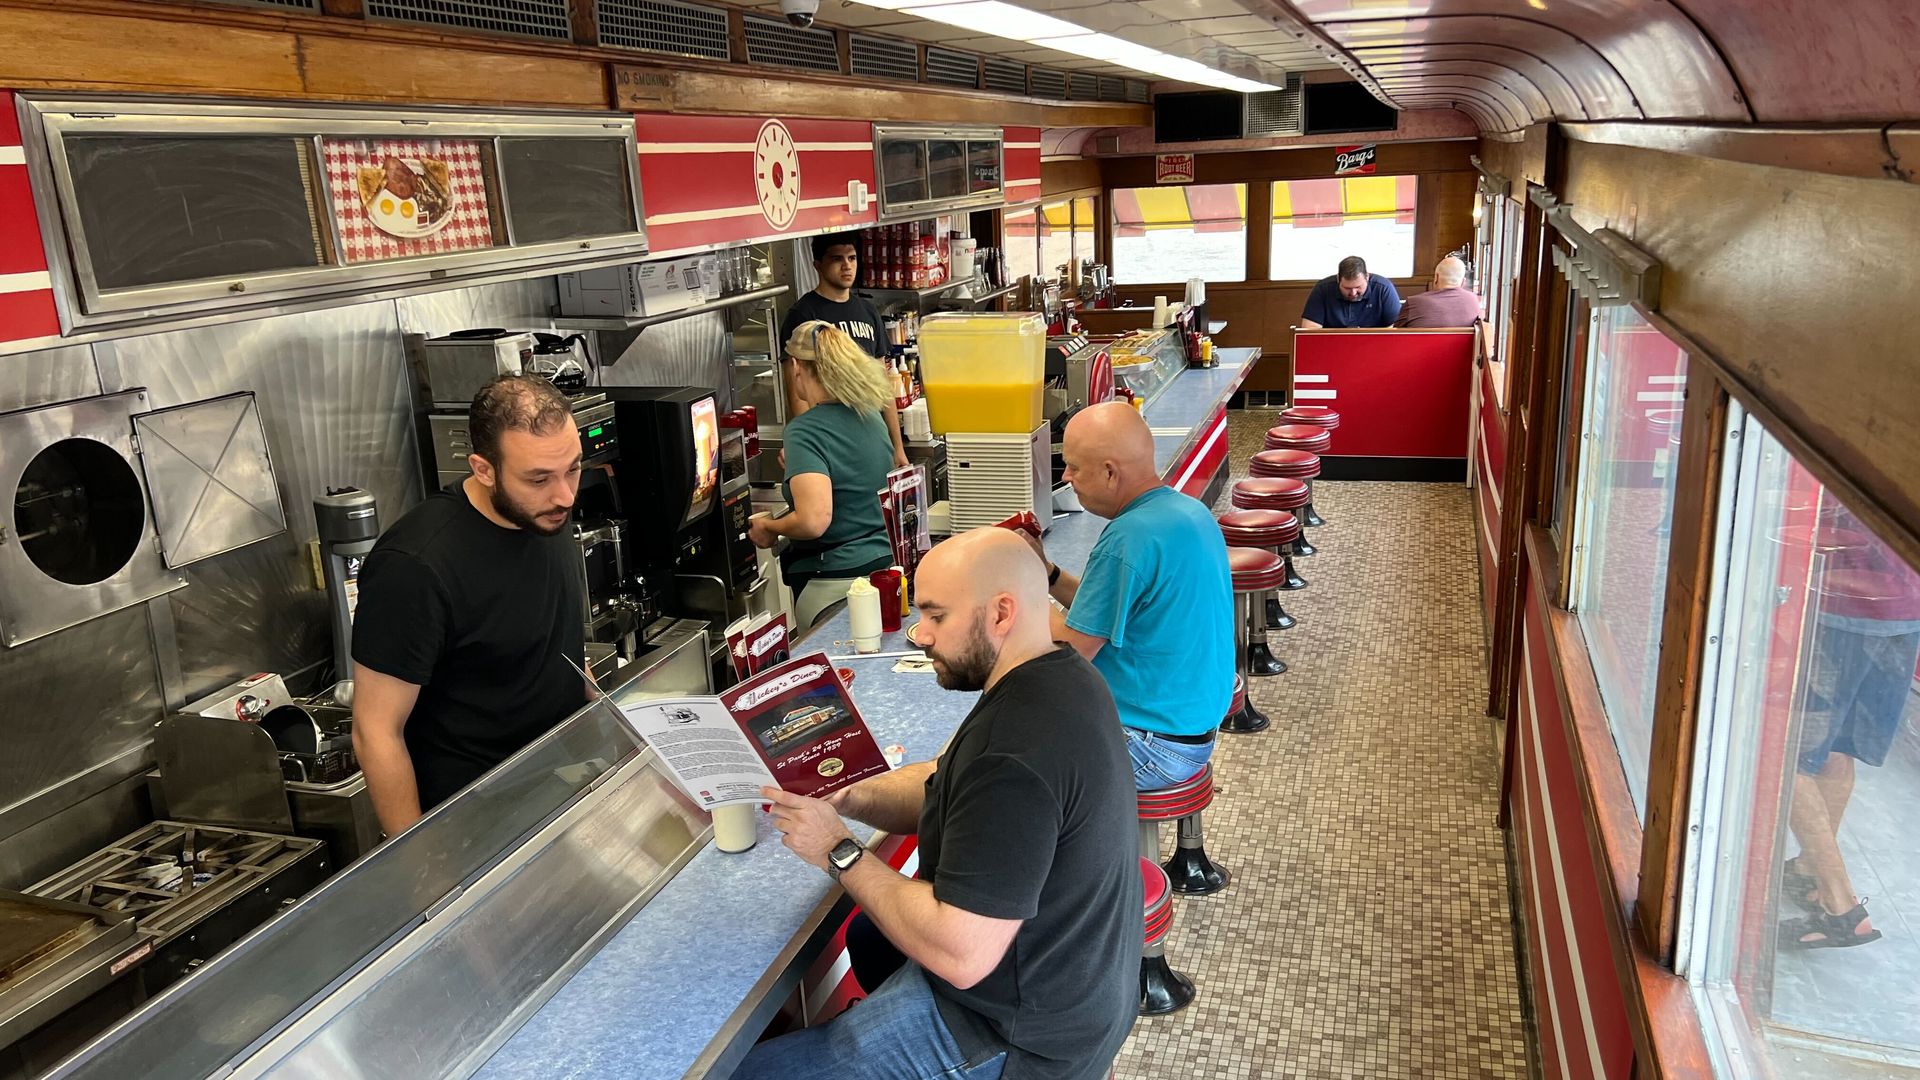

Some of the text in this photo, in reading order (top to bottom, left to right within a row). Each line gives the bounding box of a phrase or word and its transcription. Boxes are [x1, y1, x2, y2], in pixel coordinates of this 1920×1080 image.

[617, 71, 671, 88] NO SMOKING
[1159, 160, 1191, 176] ROOT BEER
[627, 267, 638, 312] KETCHUP
[850, 320, 875, 341] NAVY
[790, 670, 817, 683] Diner
[823, 737, 842, 748] Hour
[801, 752, 821, 763] Since
